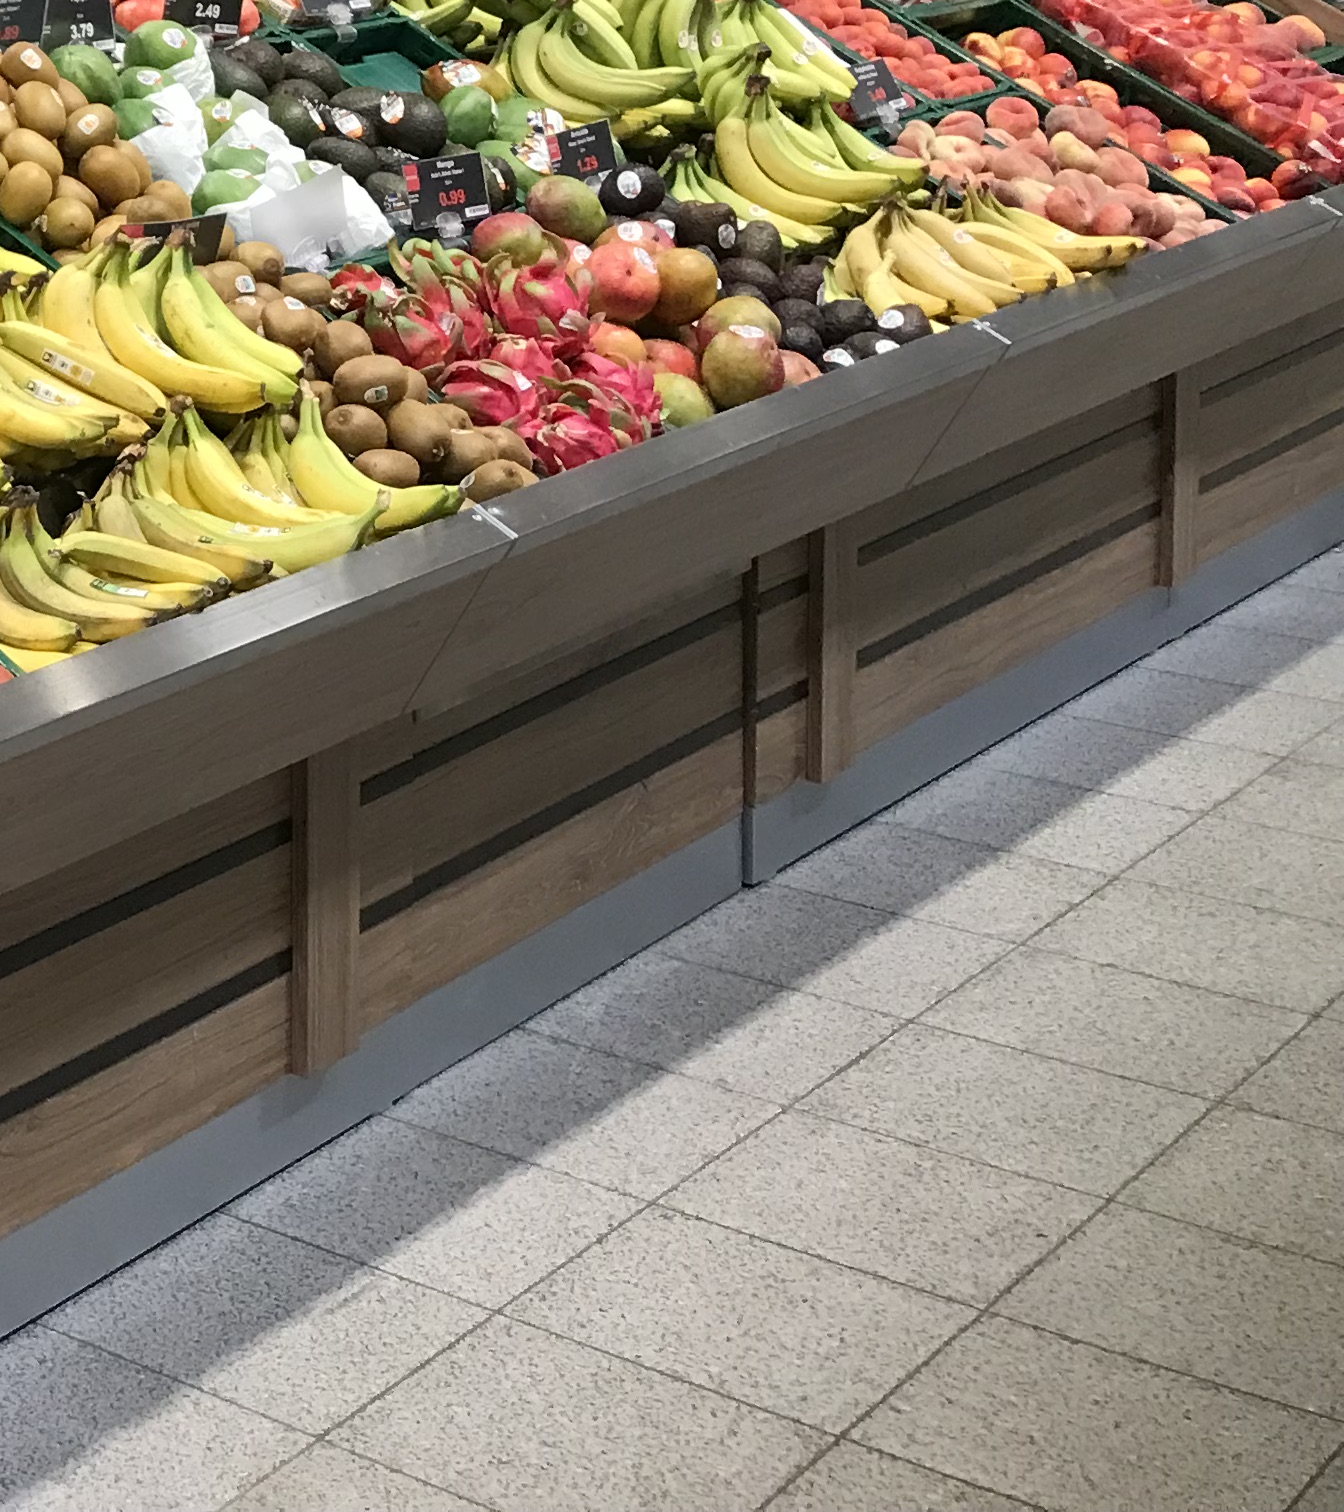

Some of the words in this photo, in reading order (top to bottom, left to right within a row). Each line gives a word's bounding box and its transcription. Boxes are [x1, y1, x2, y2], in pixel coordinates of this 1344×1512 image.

[195, 3, 222, 19] 2.49
[70, 23, 94, 39] 3.79
[438, 189, 466, 207] 0.99
